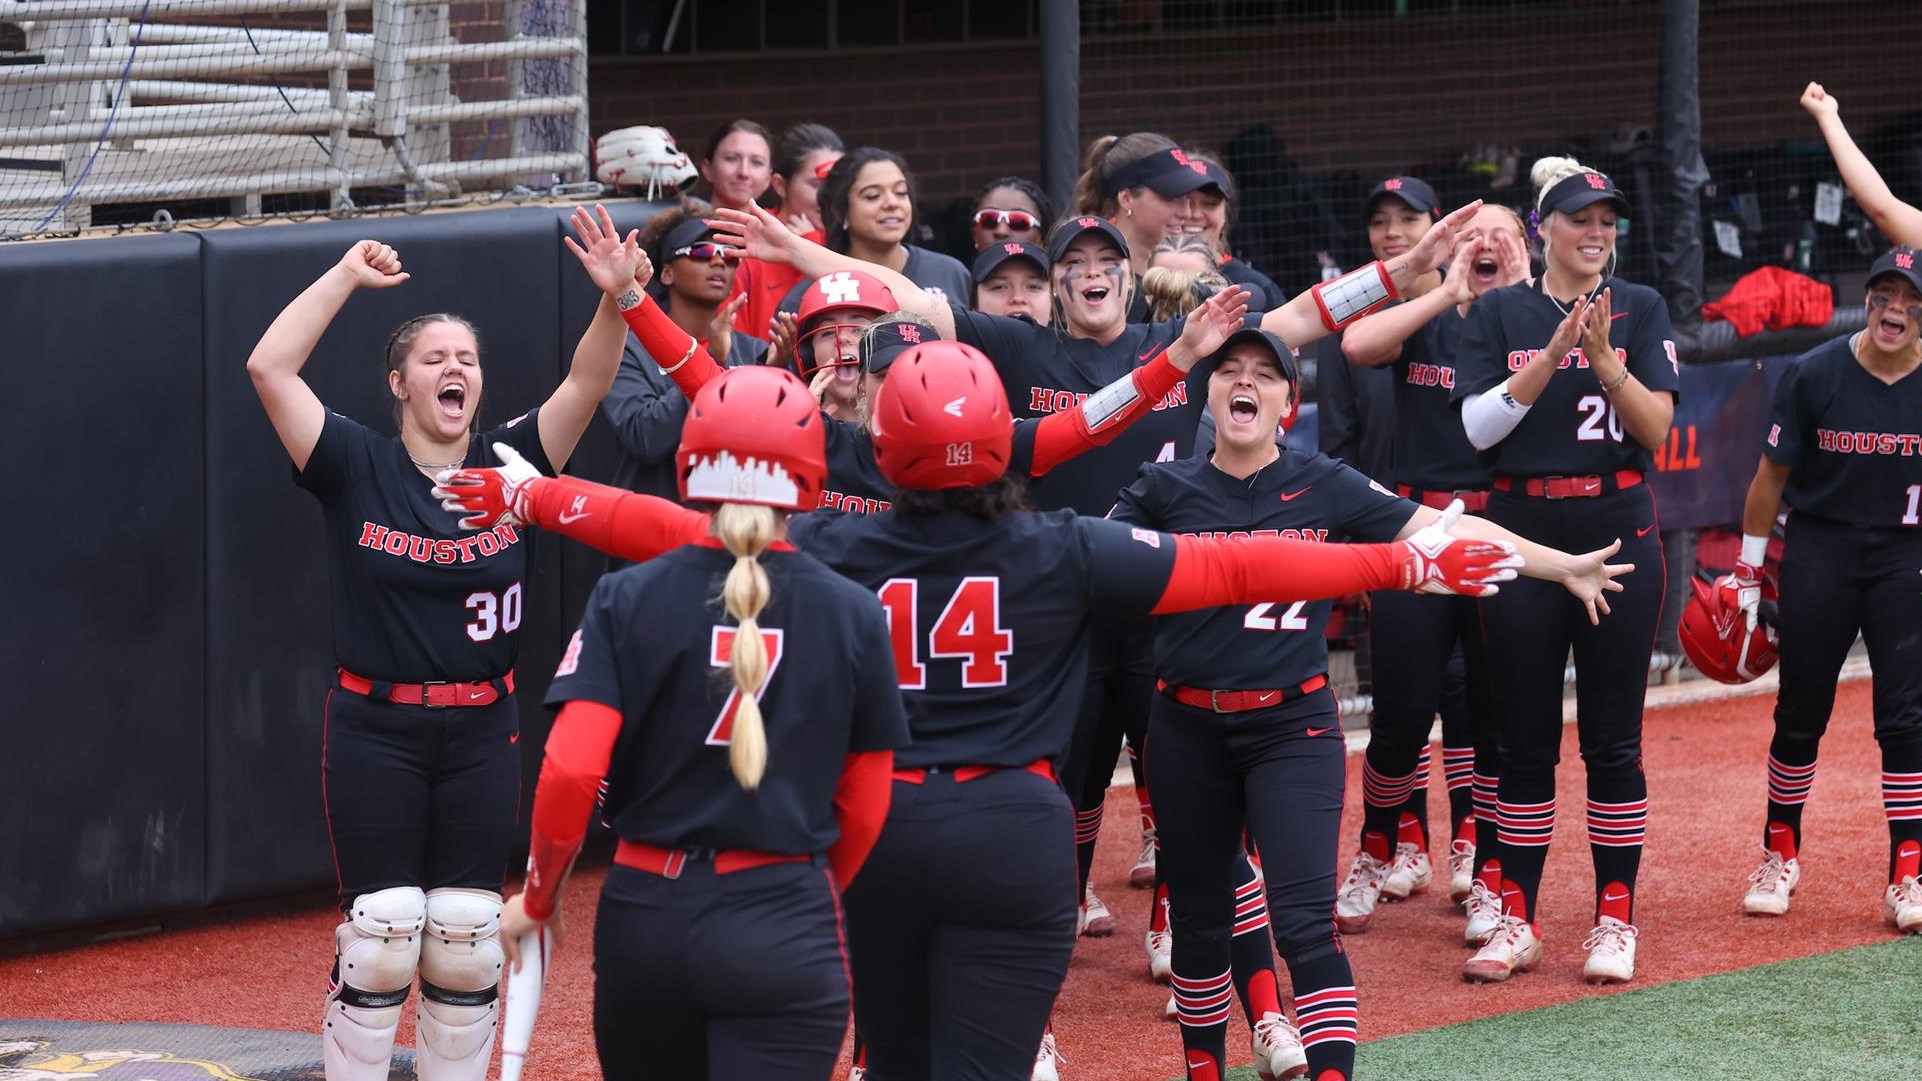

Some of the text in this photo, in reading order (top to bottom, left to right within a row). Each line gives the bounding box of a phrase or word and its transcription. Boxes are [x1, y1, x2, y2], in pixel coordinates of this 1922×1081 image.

[819, 272, 861, 304] UH
[898, 324, 921, 344] UH
[945, 441, 972, 466] 14
[358, 521, 519, 565] HOUSTON
[465, 580, 522, 642] 30
[877, 576, 1013, 690] 14
[705, 625, 784, 746] 7
